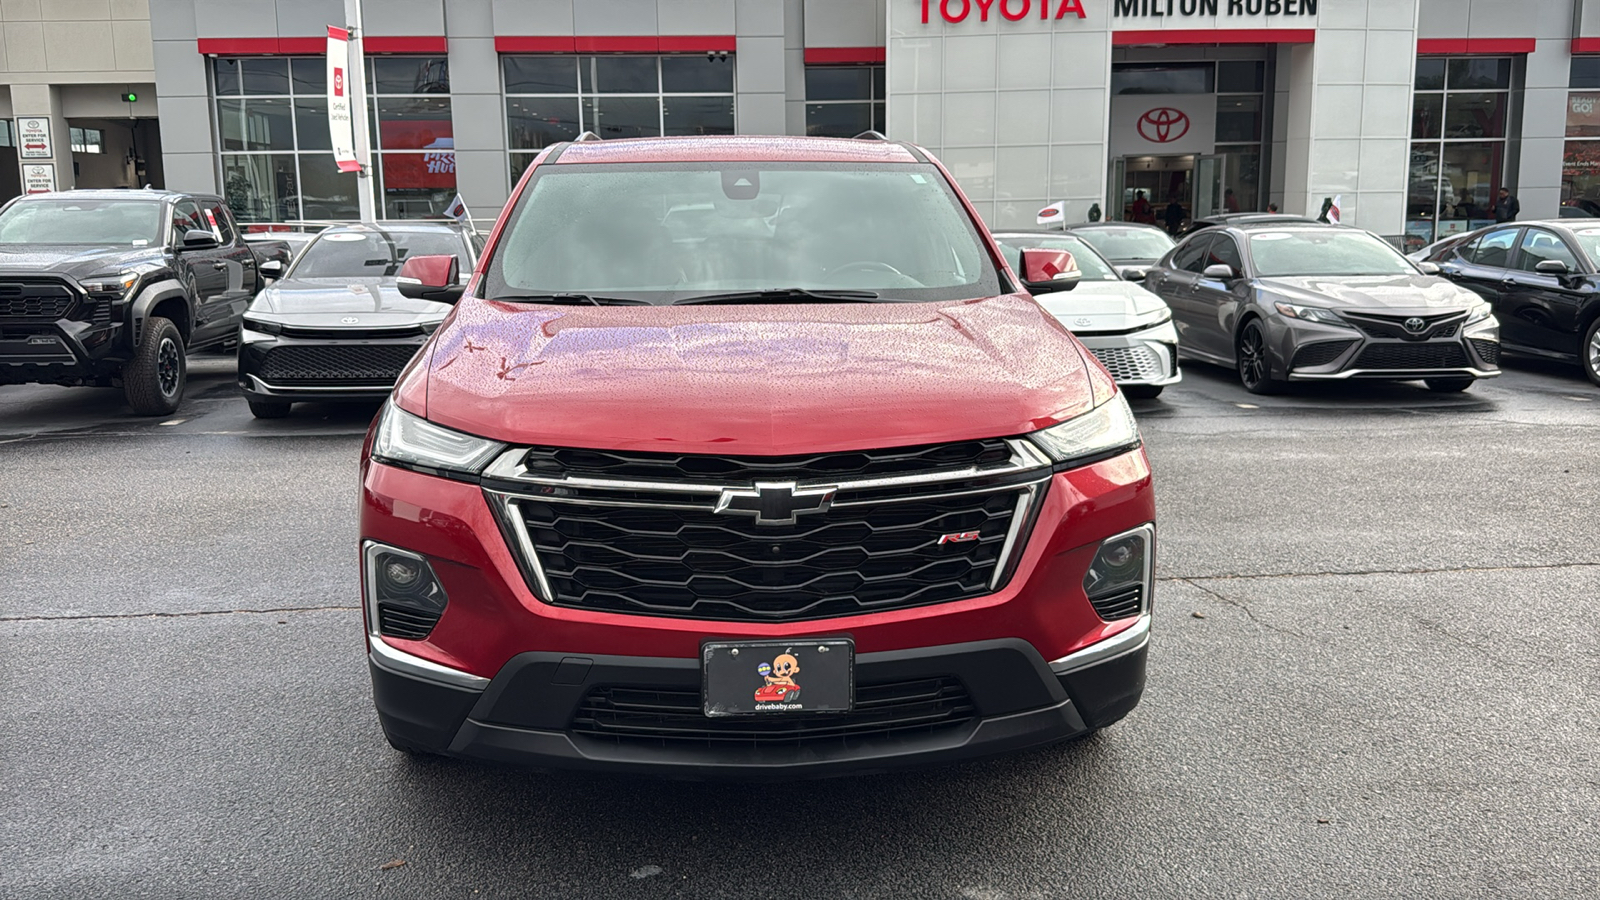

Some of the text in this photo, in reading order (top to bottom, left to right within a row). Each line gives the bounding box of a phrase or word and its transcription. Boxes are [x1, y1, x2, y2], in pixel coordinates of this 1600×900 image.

[1572, 103, 1593, 114] GO!
[937, 530, 981, 545] RS
[755, 703, 803, 711] drivebaby.com
